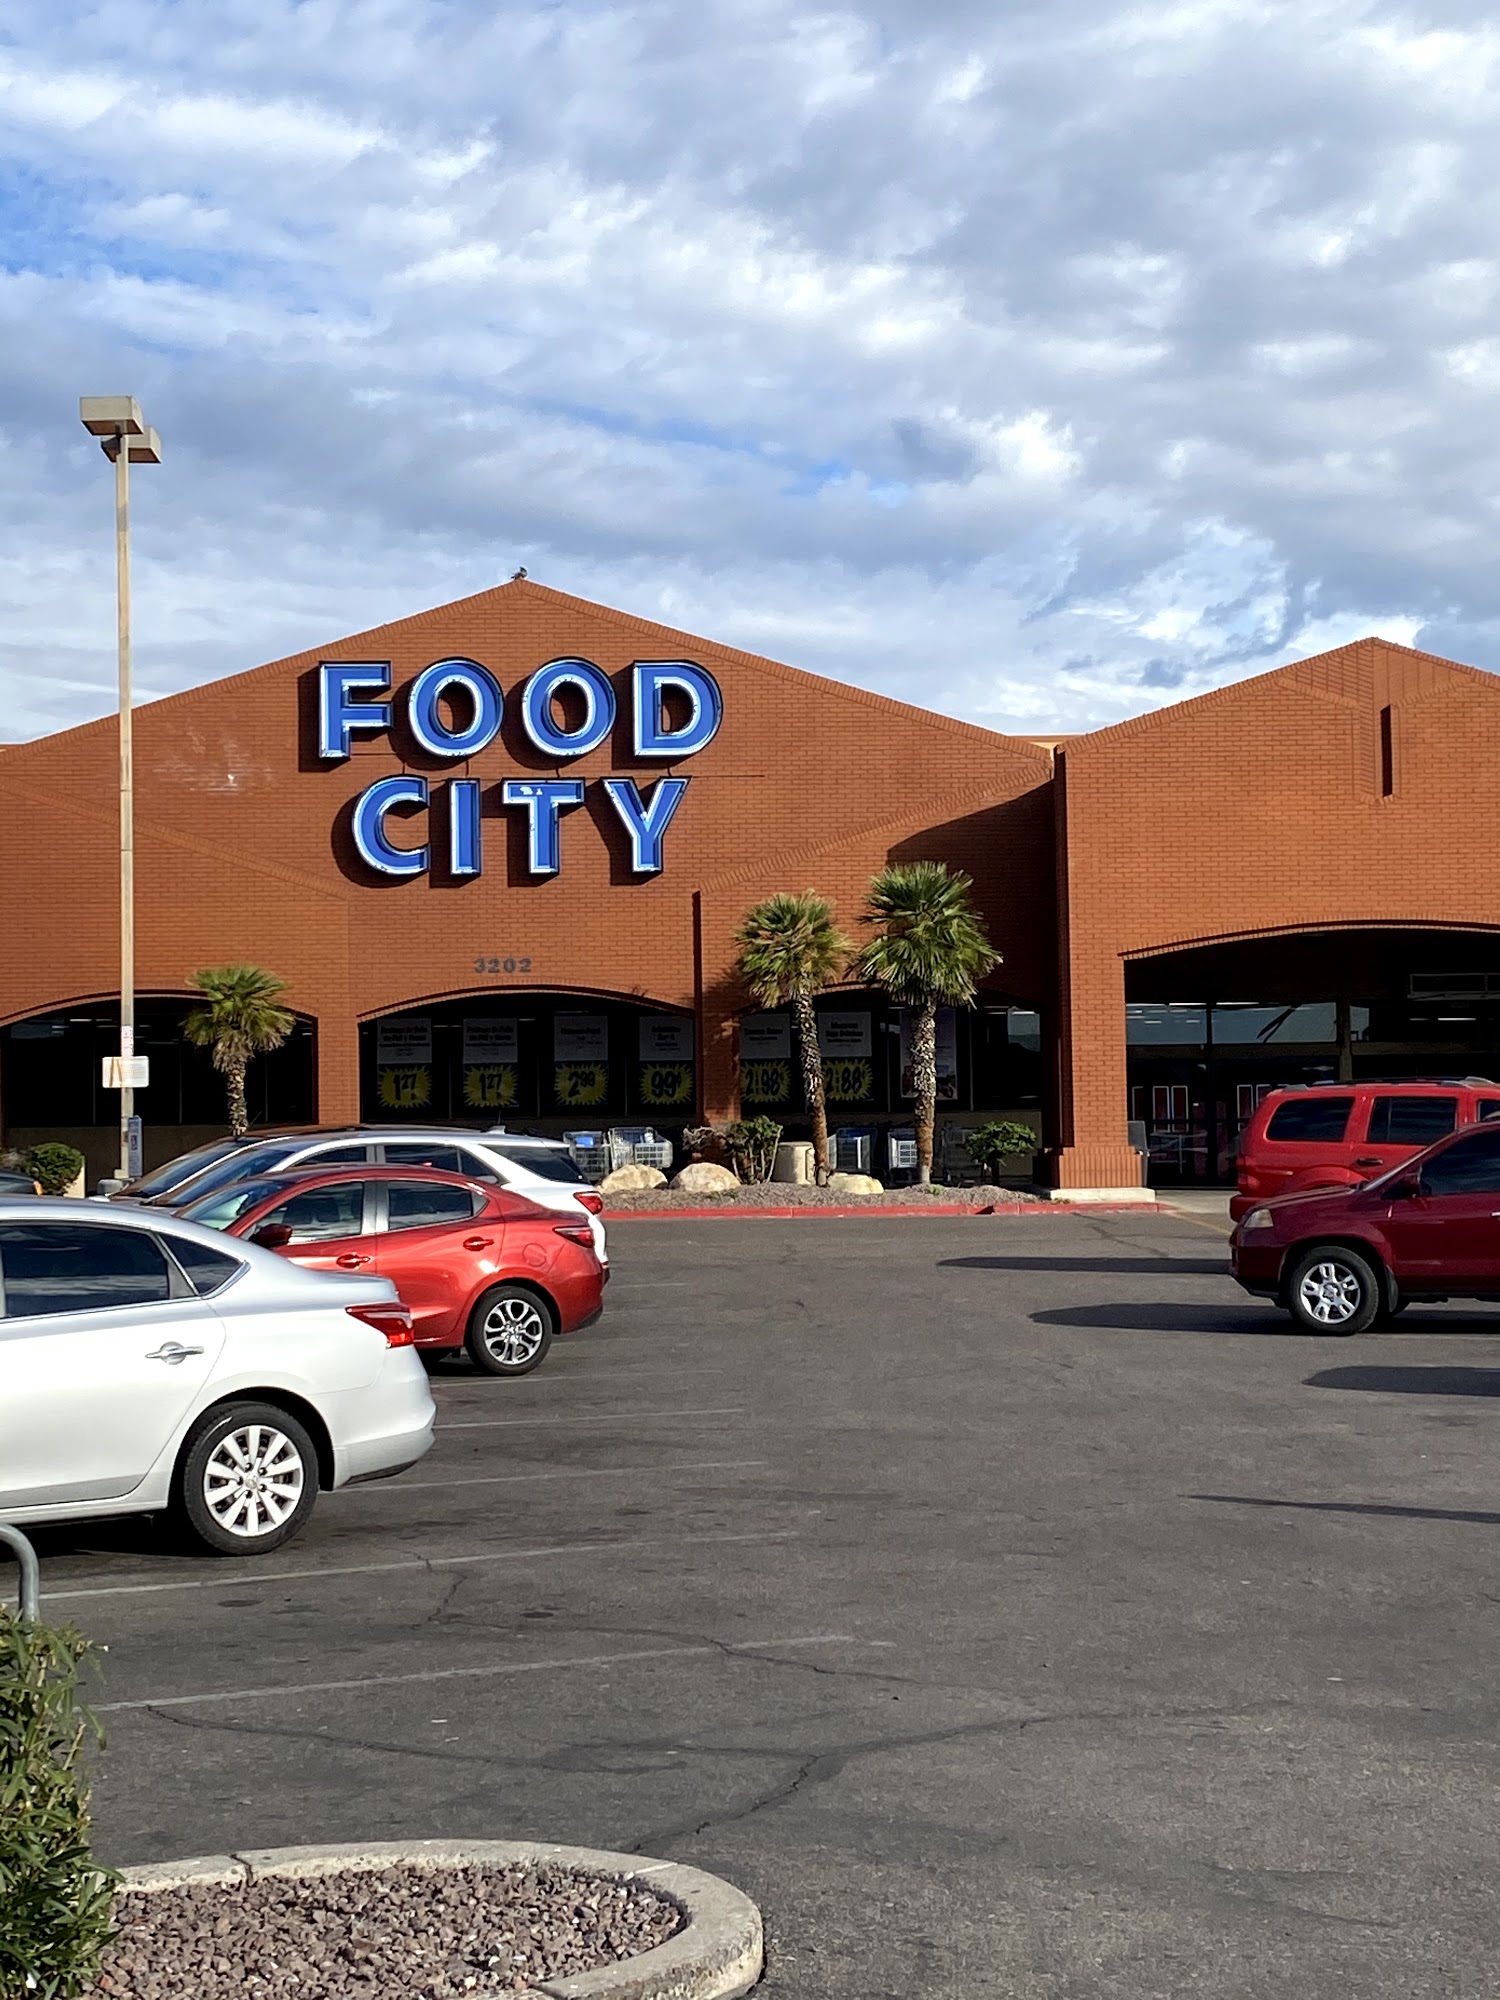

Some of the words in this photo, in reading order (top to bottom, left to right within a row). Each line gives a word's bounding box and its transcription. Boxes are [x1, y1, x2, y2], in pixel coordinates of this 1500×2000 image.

[318, 656, 724, 759] FOOD
[351, 773, 693, 876] CITY
[474, 958, 532, 974] 3202
